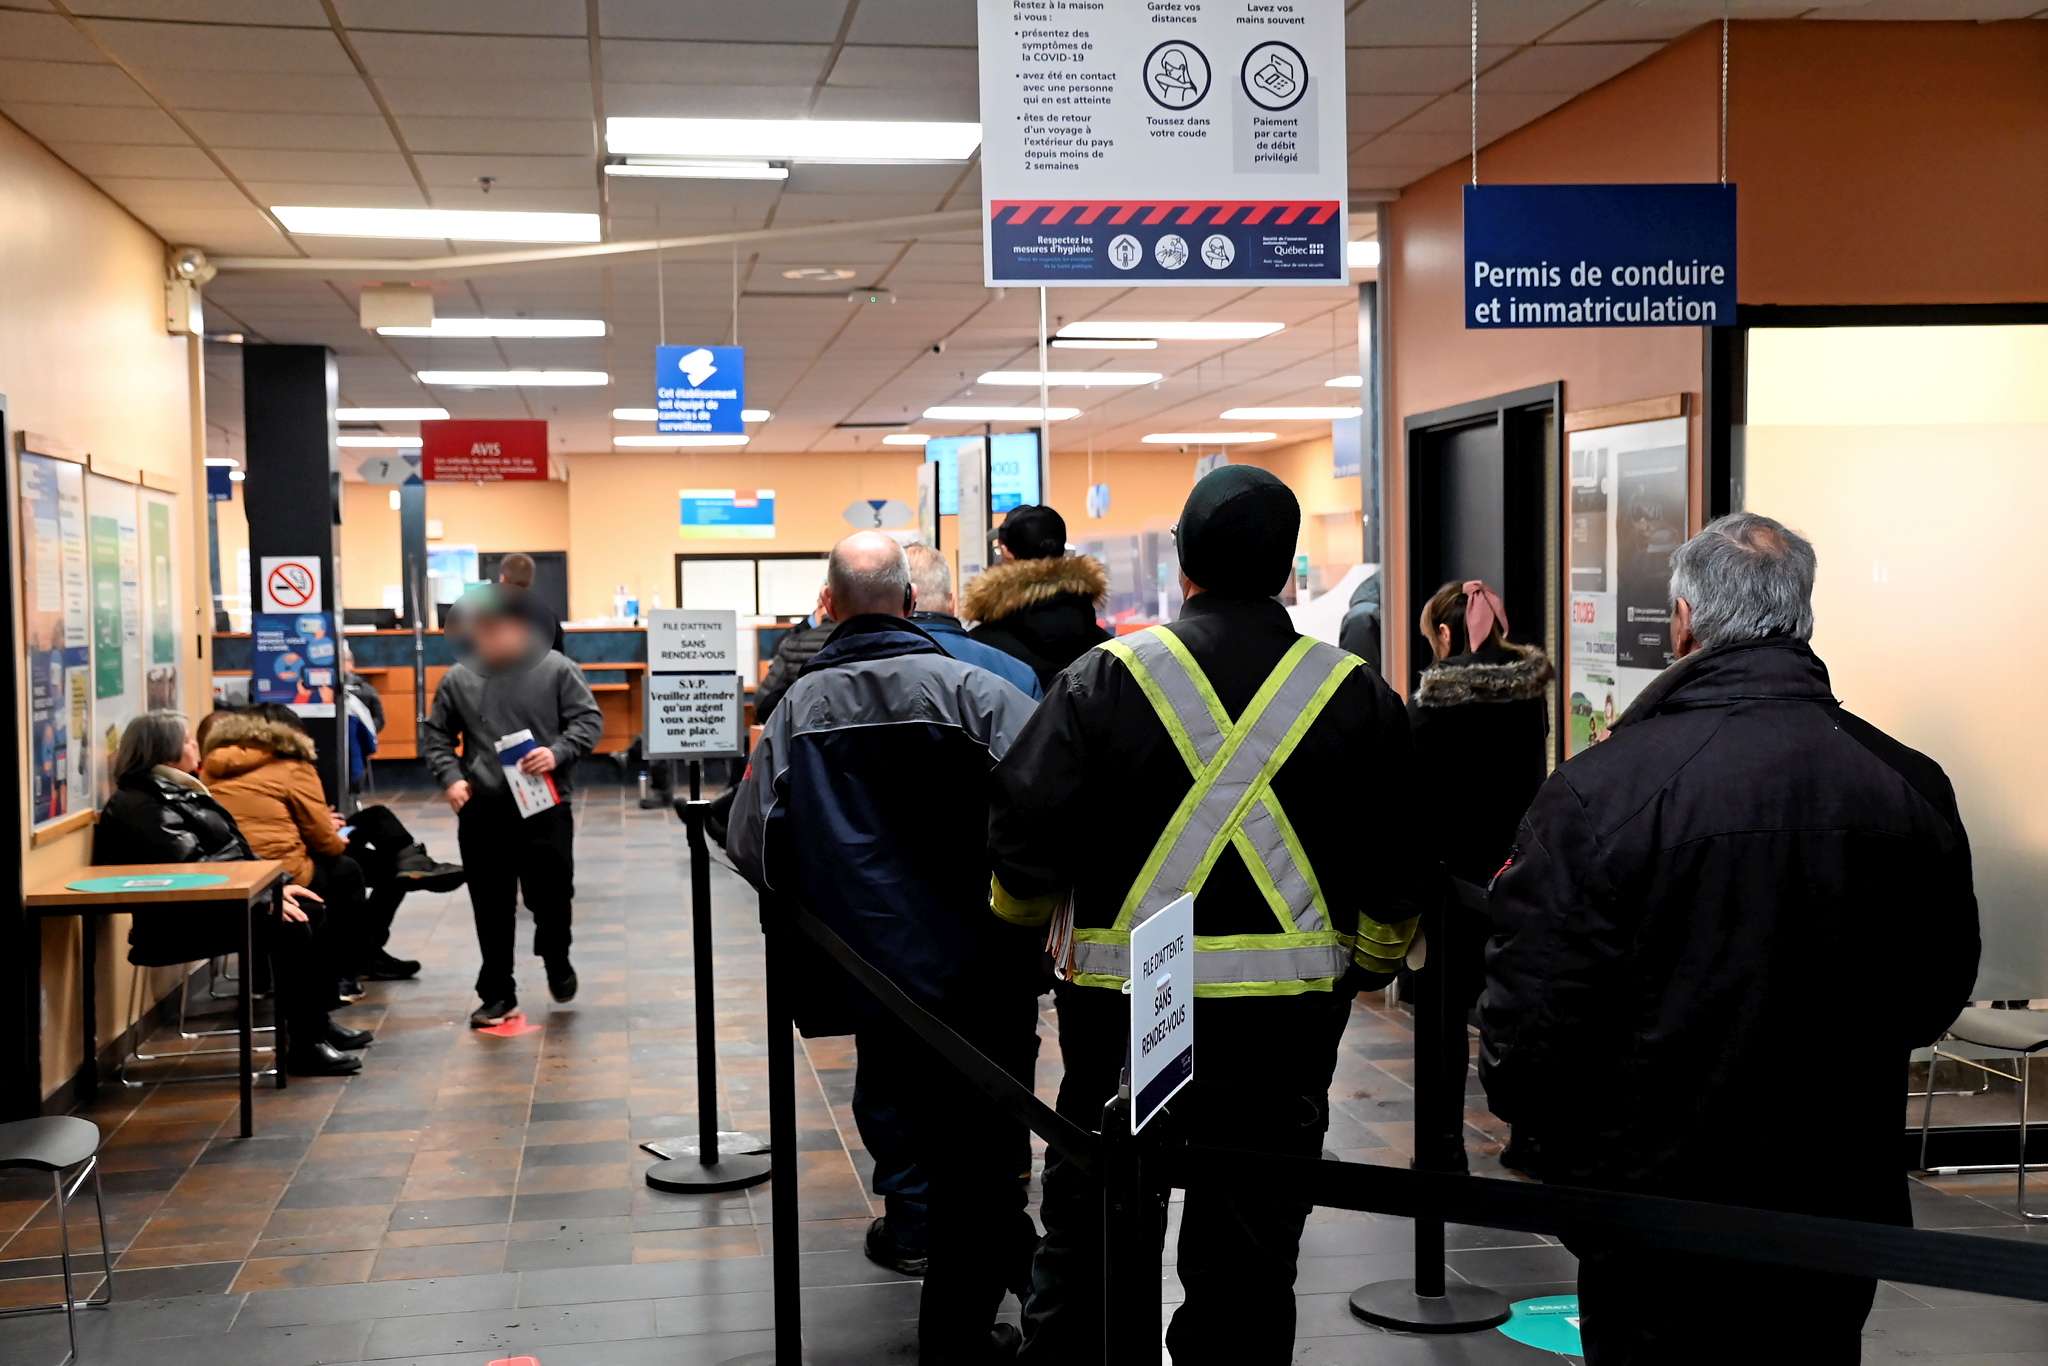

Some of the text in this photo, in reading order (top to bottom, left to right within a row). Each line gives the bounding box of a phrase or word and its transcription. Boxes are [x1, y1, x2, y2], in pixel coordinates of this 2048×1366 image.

[1014, 0, 1104, 10] Restez à la maison
[1148, 2, 1182, 10] Gardez
[1248, 4, 1274, 12] Lavez
[1014, 12, 1022, 20] si
[1152, 14, 1196, 24] distances
[1236, 16, 1304, 24] mains souvent
[1022, 28, 1090, 38] présentez des
[1022, 40, 1092, 52] symptômes de
[1022, 52, 1084, 62] la COVID-19
[1048, 70, 1062, 80] été
[1080, 72, 1116, 80] contact
[1068, 86, 1114, 94] personne
[1024, 97, 1038, 105] qui
[1056, 96, 1070, 104] est
[1074, 96, 1112, 104] atteinte
[1024, 112, 1092, 122] êtes de retour
[1146, 116, 1210, 126] Toussez dans
[1254, 116, 1298, 126] Paiement
[1024, 124, 1092, 136] d'un voyage à
[1150, 128, 1206, 138] votre coude
[1254, 130, 1298, 140] par carte
[1024, 136, 1114, 148] l'extérieur du pays
[1256, 140, 1296, 150] de débit
[1024, 150, 1104, 160] depuis moins de
[1254, 152, 1298, 164] privilégié
[1026, 162, 1080, 170] 2 semaines
[1037, 236, 1094, 247] Respectez les
[1050, 244, 1094, 256] d'hygiène.
[1274, 246, 1308, 256] Québec
[1474, 260, 1724, 288] Permis de conduire
[1474, 296, 1716, 324] et immatriculation
[470, 442, 501, 456] AVIS
[378, 461, 390, 478] 7
[992, 461, 1020, 476] 003
[680, 622, 722, 630] D'ATTENTE
[682, 640, 706, 648] SANS
[662, 650, 726, 660] RENDEZ-VOUS
[678, 680, 708, 688] S.V.P.
[651, 692, 735, 700] Veuillez attendre
[662, 704, 724, 714] qu'un agent
[687, 716, 726, 725] assigne
[690, 726, 718, 738] place.
[680, 740, 706, 748] Merci!
[1143, 935, 1184, 980] FILE D'ATTENTE
[1154, 986, 1172, 1016] SANS
[1142, 1004, 1185, 1058] RENDEZ-VOUS
